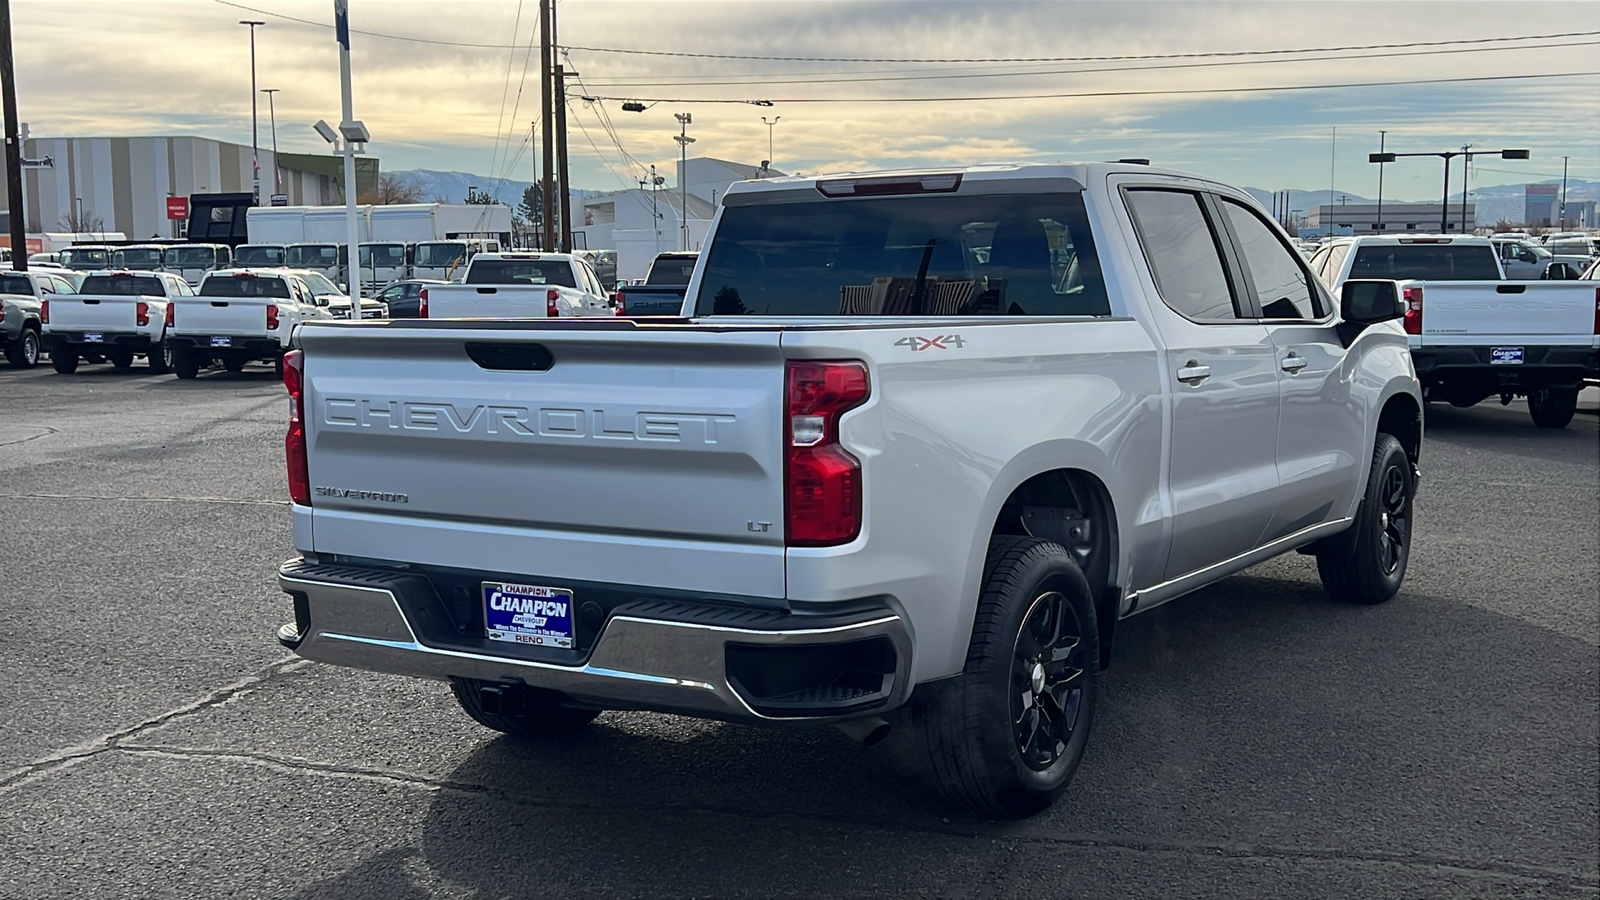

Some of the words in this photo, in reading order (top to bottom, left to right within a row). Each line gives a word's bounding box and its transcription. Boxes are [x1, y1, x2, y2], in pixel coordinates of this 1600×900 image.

[323, 397, 737, 444] CHEVROLET
[315, 485, 408, 503] SILVERADO
[747, 520, 772, 532] LT
[505, 585, 547, 596] CHAMPION
[490, 592, 567, 618] CHAMPION
[514, 615, 545, 625] CHEVROLET
[515, 635, 544, 645] RENO
